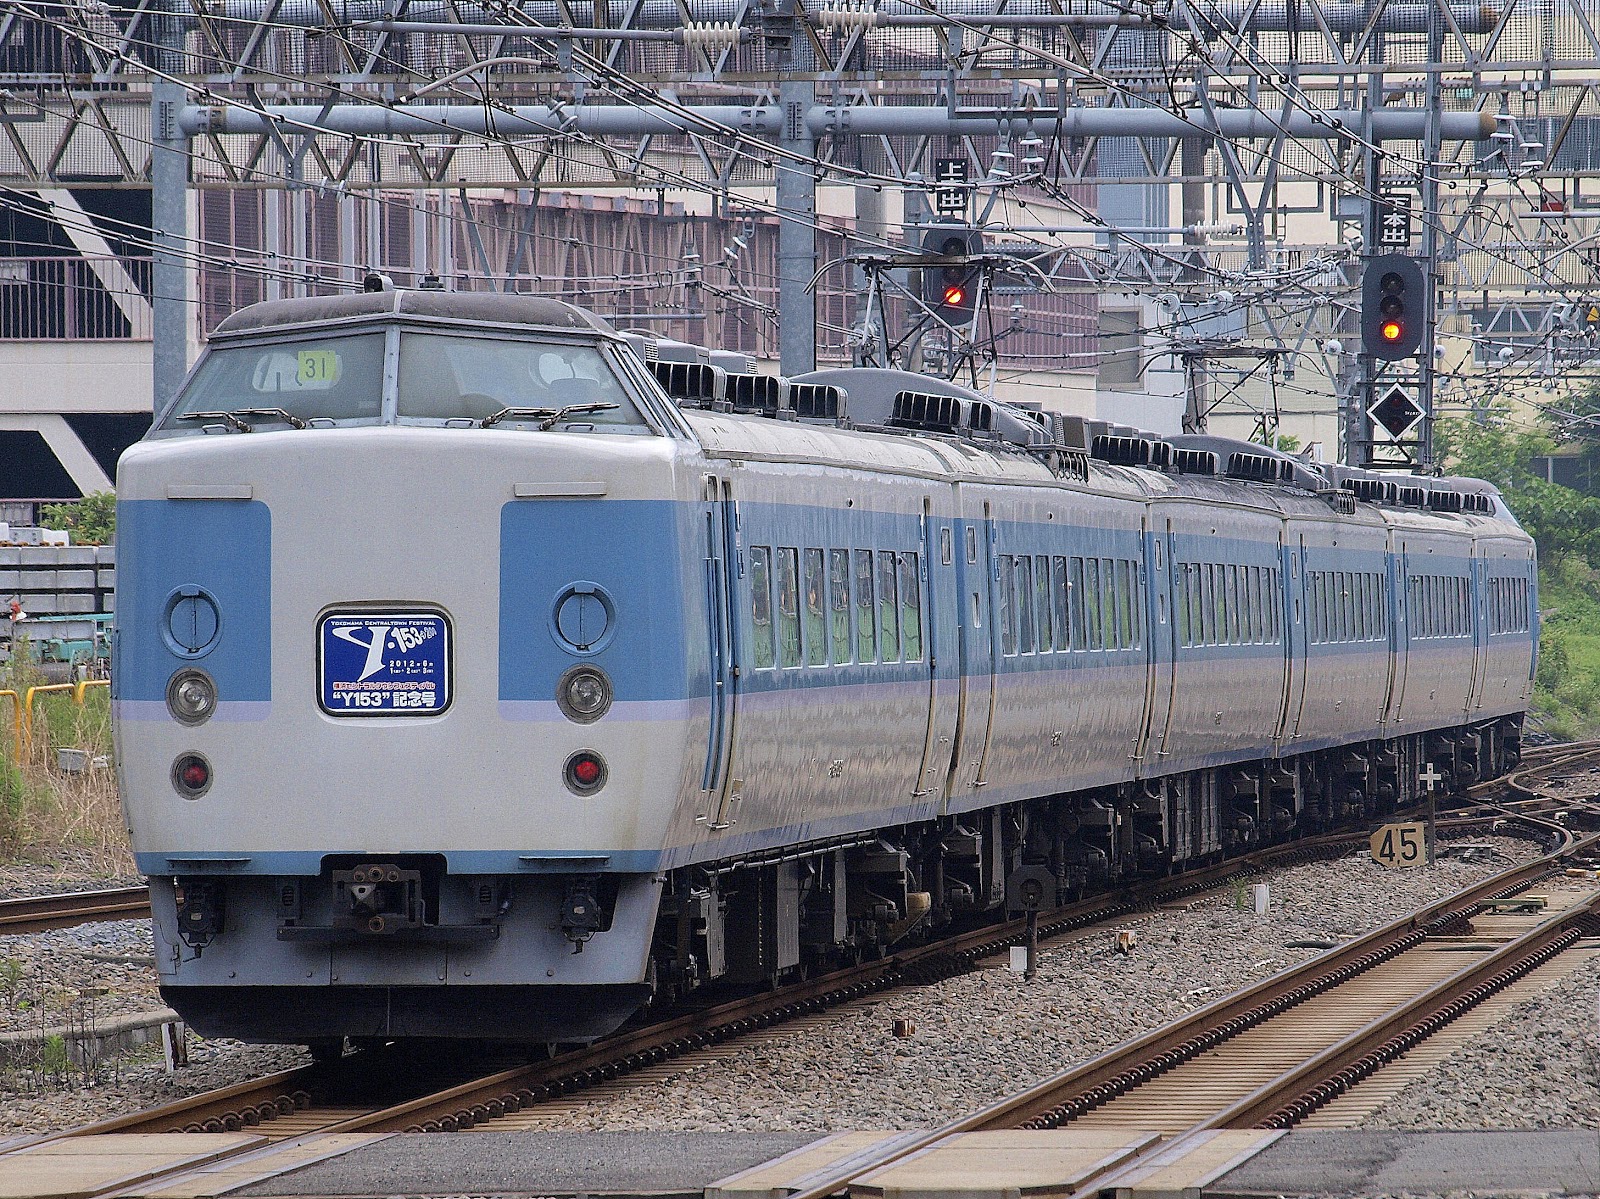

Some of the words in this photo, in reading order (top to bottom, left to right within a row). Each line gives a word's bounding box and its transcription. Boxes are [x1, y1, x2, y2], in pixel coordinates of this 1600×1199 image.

[1383, 197, 1408, 242] 下本出
[305, 358, 325, 378] 31
[393, 691, 436, 707] 記念号
[1380, 828, 1418, 862] 45
